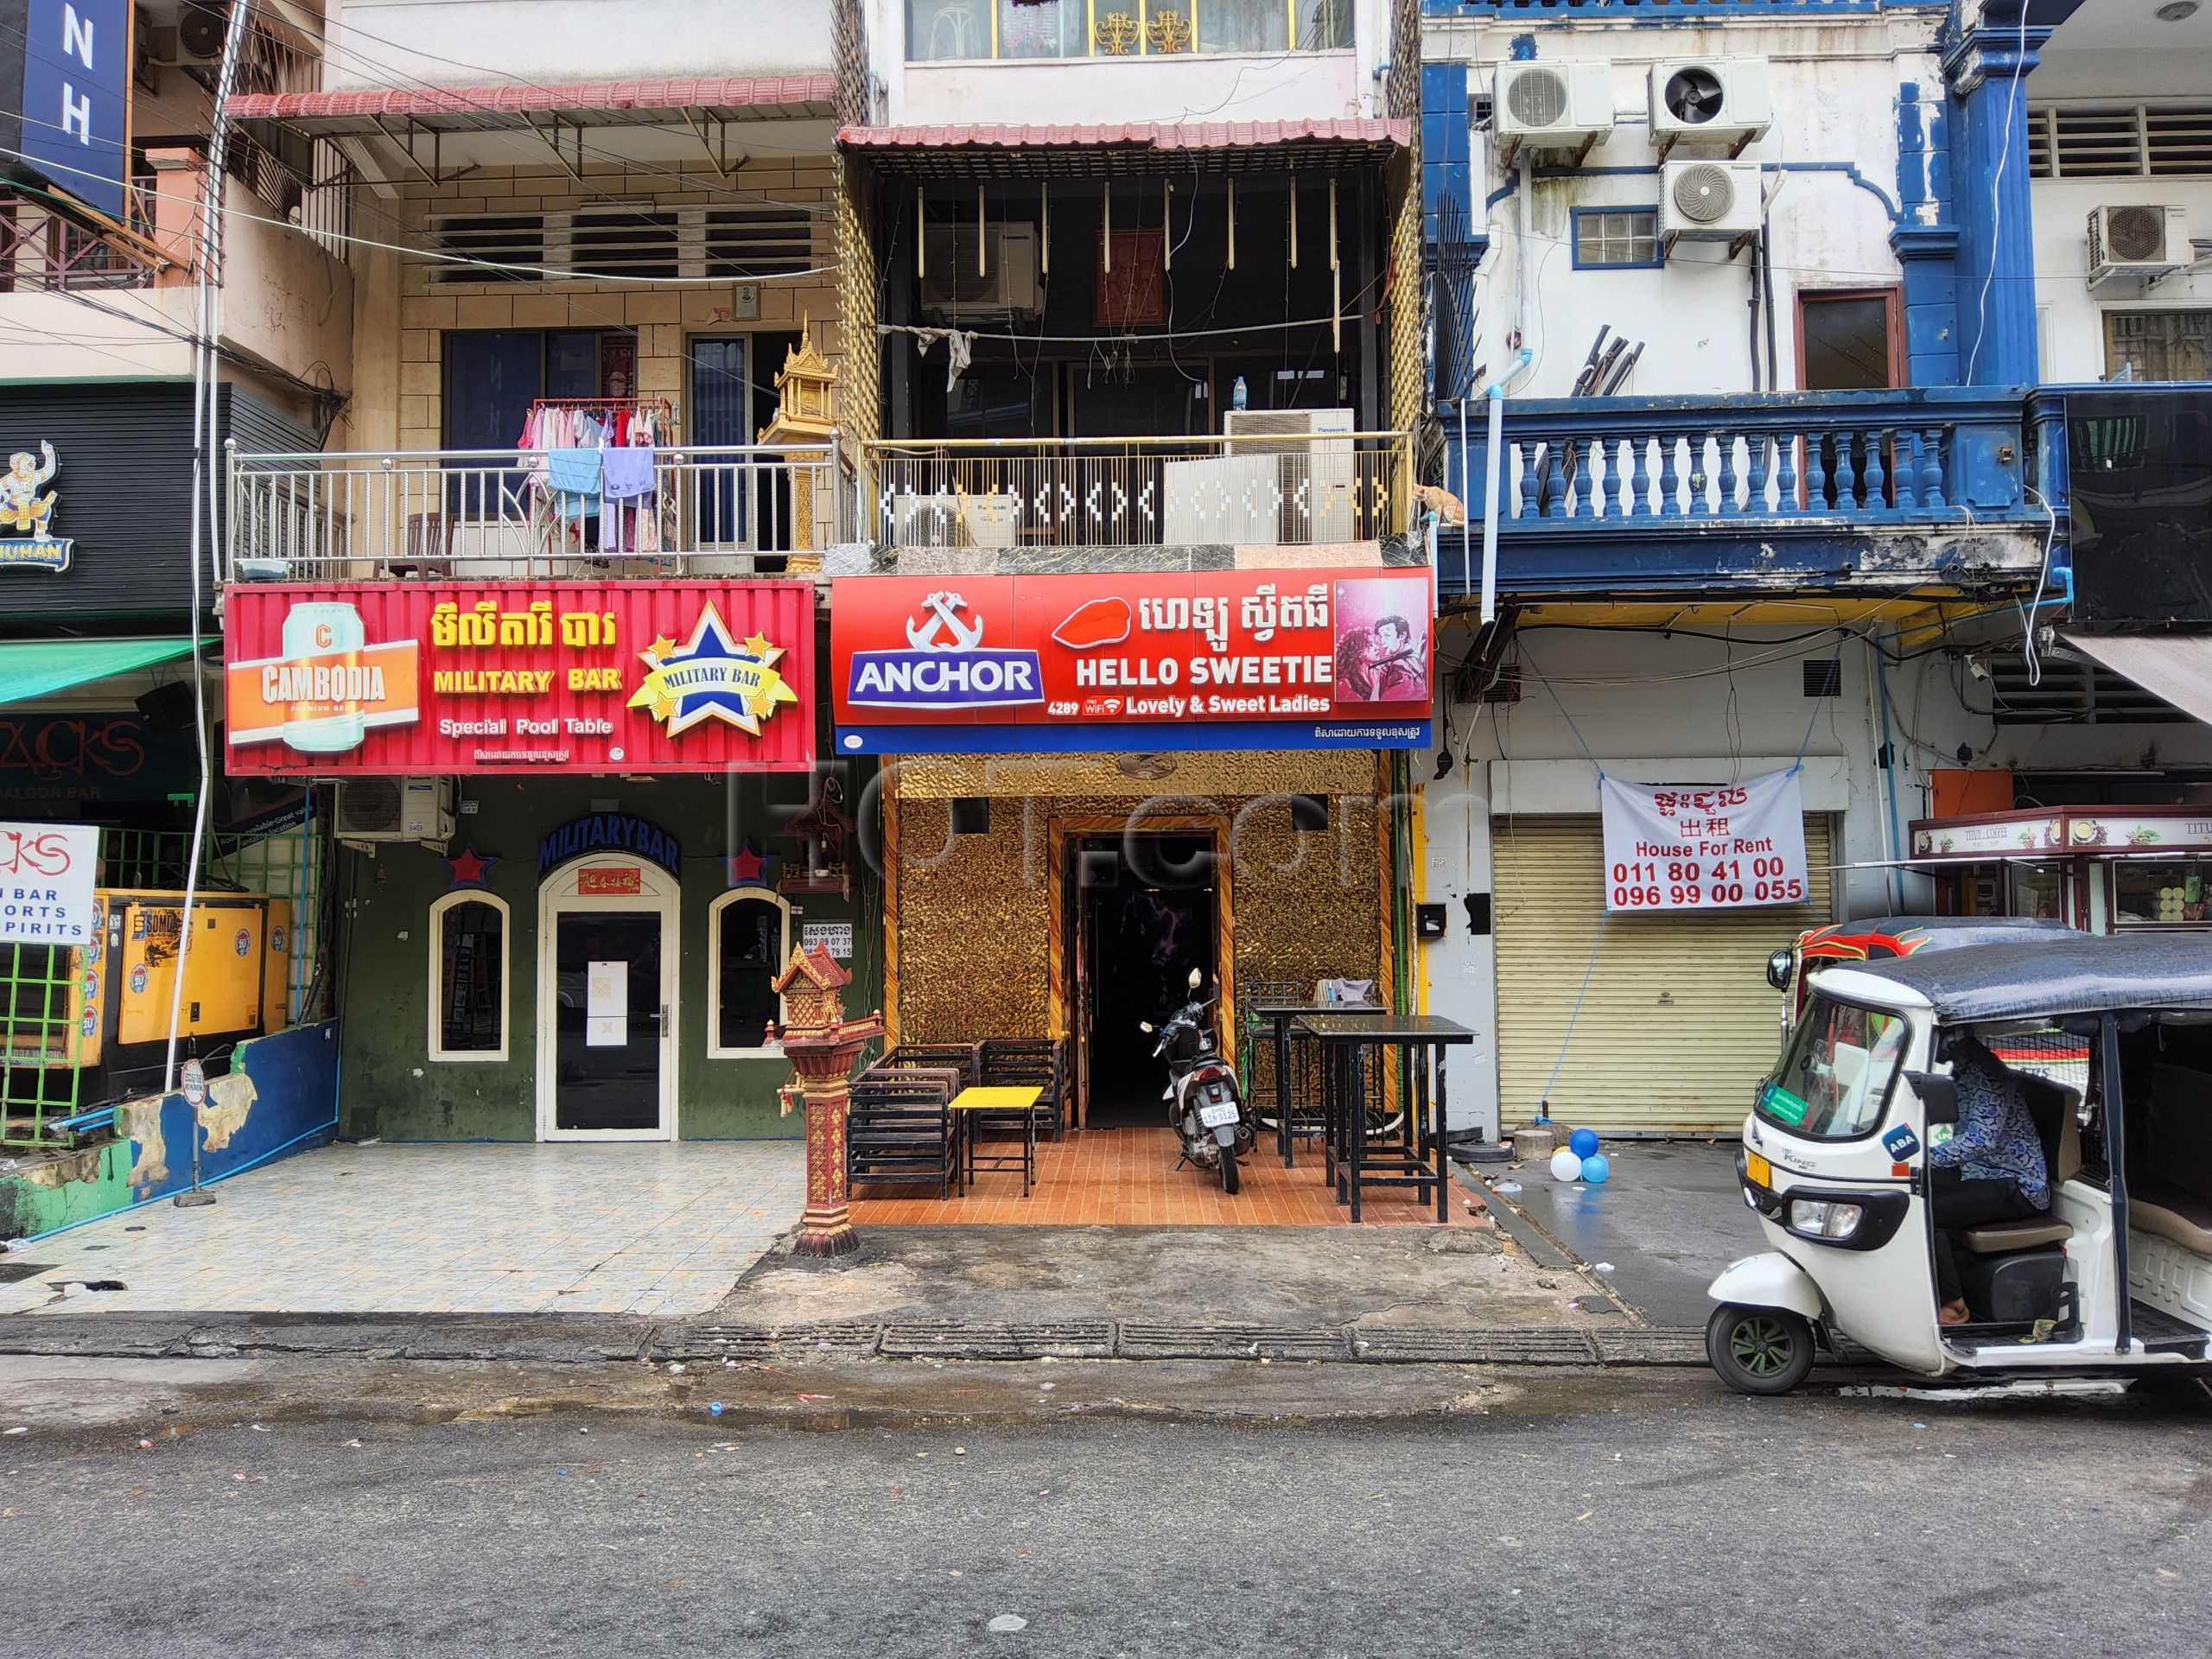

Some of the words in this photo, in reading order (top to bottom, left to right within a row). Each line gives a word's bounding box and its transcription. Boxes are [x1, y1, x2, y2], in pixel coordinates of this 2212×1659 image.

[434, 669, 555, 694] MILITARY
[568, 667, 623, 691] BAR
[663, 667, 728, 690] MILITARY
[731, 668, 761, 689] BAR
[855, 660, 1035, 693] ANCHOR
[1076, 657, 1179, 686] HELLO
[1190, 654, 1332, 685] SWEETIE
[262, 664, 386, 704] CAMBODIA
[1048, 702, 1078, 716] 4289
[1085, 704, 1104, 715] WiFi
[1126, 696, 1186, 718] Lovely
[1189, 695, 1206, 715] &
[1209, 694, 1265, 714] Sweet
[1269, 694, 1331, 713] Ladies
[440, 718, 506, 739] Special
[516, 718, 559, 735] Pool
[564, 718, 614, 735] Table
[1680, 817, 1732, 838] 出租
[1636, 842, 1694, 857] House
[1700, 841, 1728, 856] For
[1734, 836, 1773, 854] Rent
[1613, 862, 1656, 883] 011
[1668, 861, 1700, 882] 80
[1711, 860, 1740, 880] 41
[1753, 856, 1784, 878] 00
[14, 887, 57, 900] BAR
[1613, 886, 1661, 906] 096
[1670, 885, 1701, 904] 99
[1712, 883, 1743, 903] 00
[1754, 878, 1802, 901] 055
[0, 921, 82, 936] PIRITS
[804, 938, 817, 946] 093
[830, 938, 840, 946] 07
[842, 938, 852, 946] 37
[1890, 1134, 1916, 1154] ABA
[1783, 1154, 1818, 1167] KING
